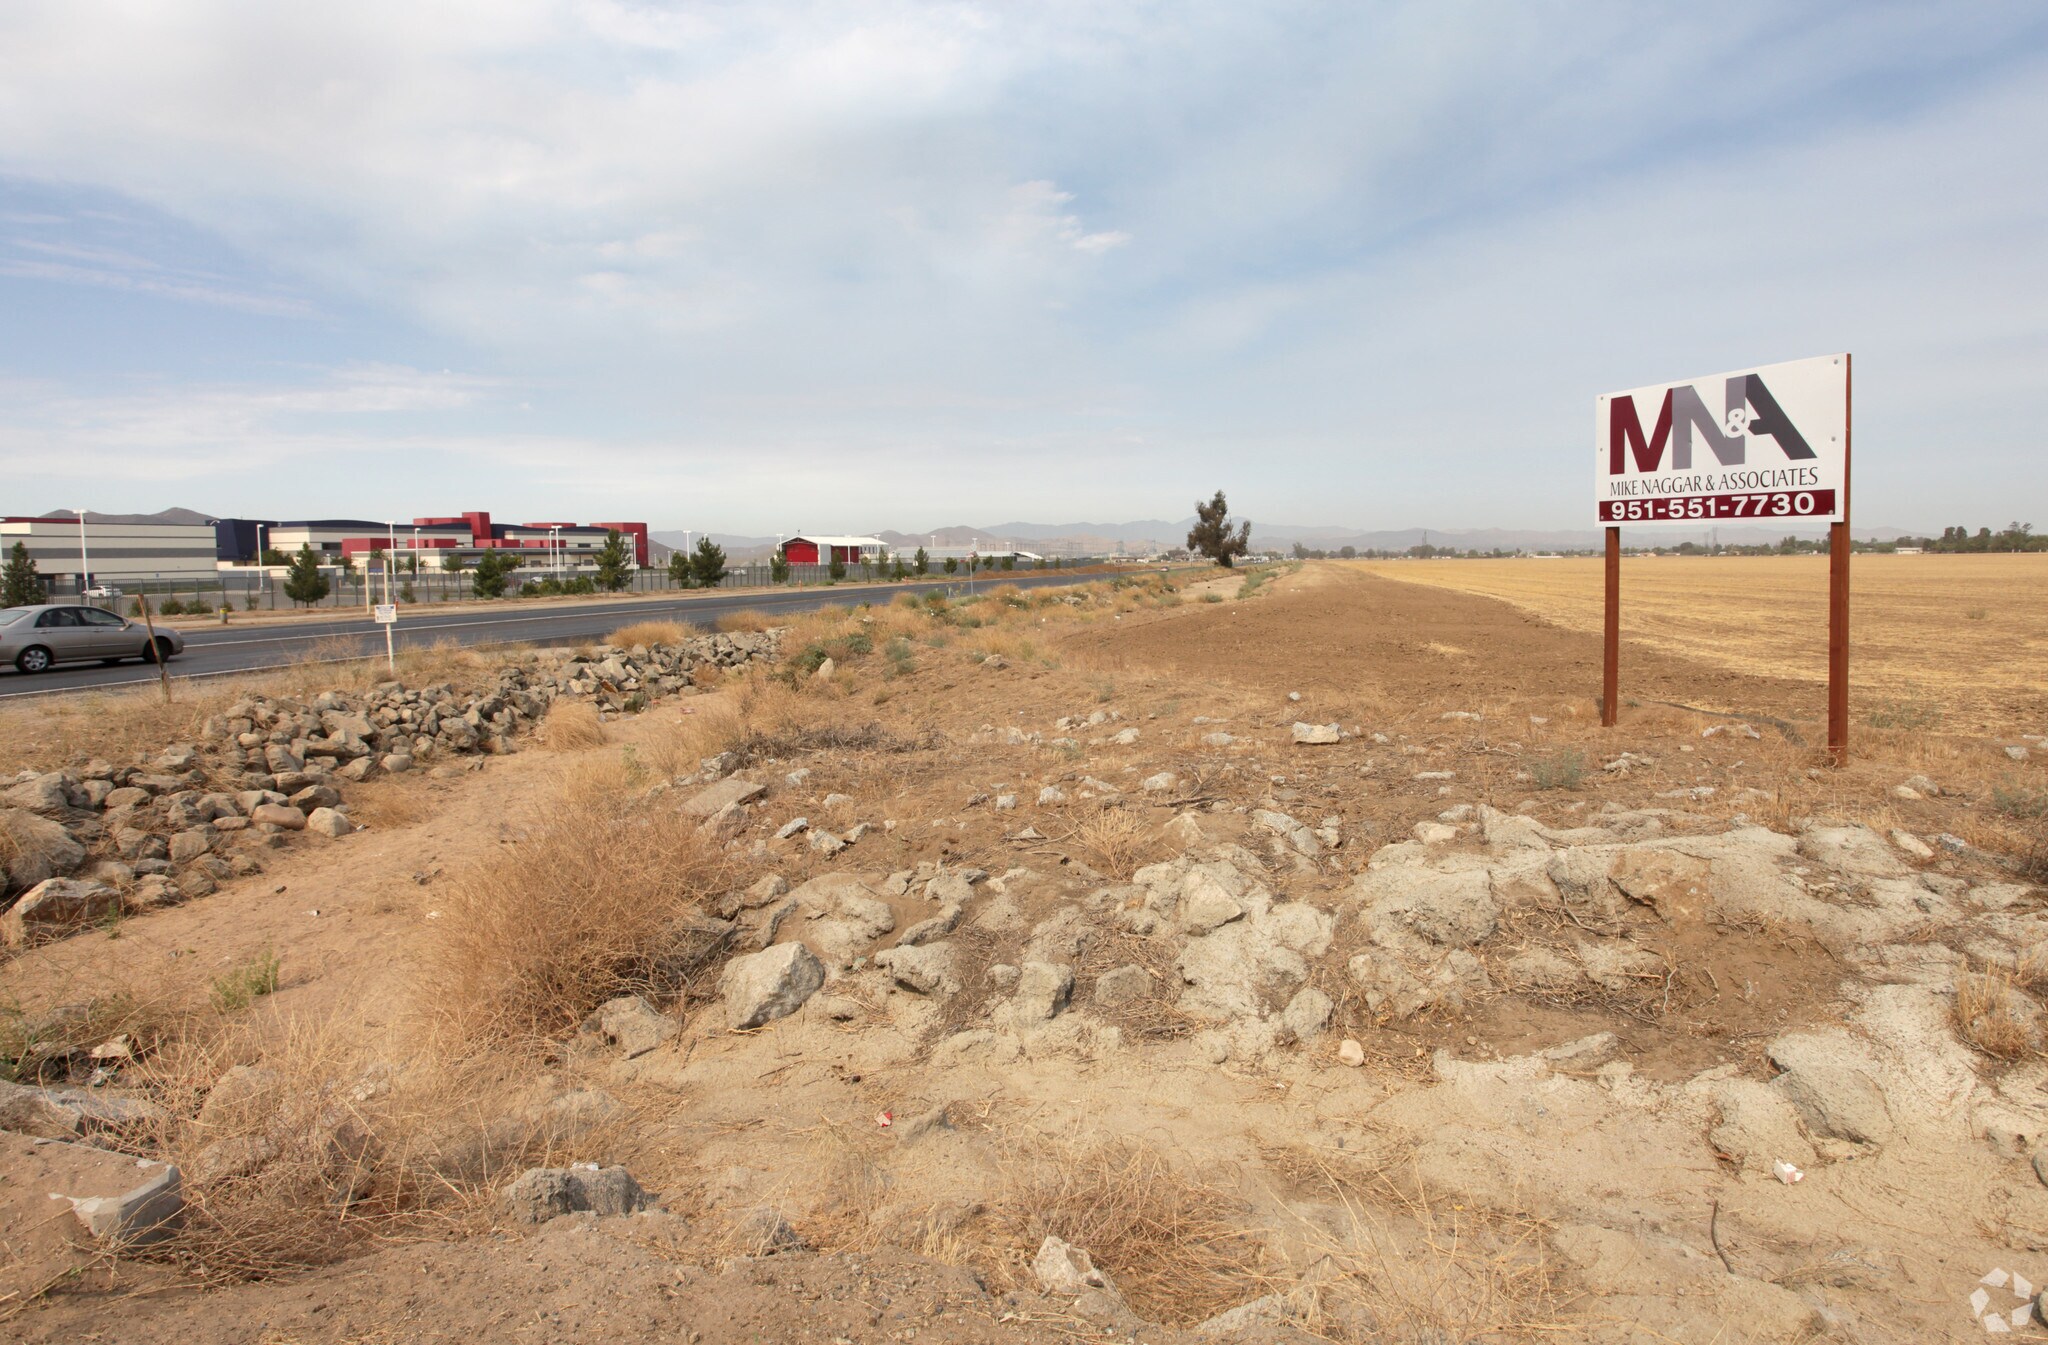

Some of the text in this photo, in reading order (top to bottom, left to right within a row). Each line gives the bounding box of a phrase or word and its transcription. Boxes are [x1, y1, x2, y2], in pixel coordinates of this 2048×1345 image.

[1610, 467, 1818, 496] MIKE NAGGAR & ASSOCIATES
[1611, 492, 1815, 519] 951-551-7730
